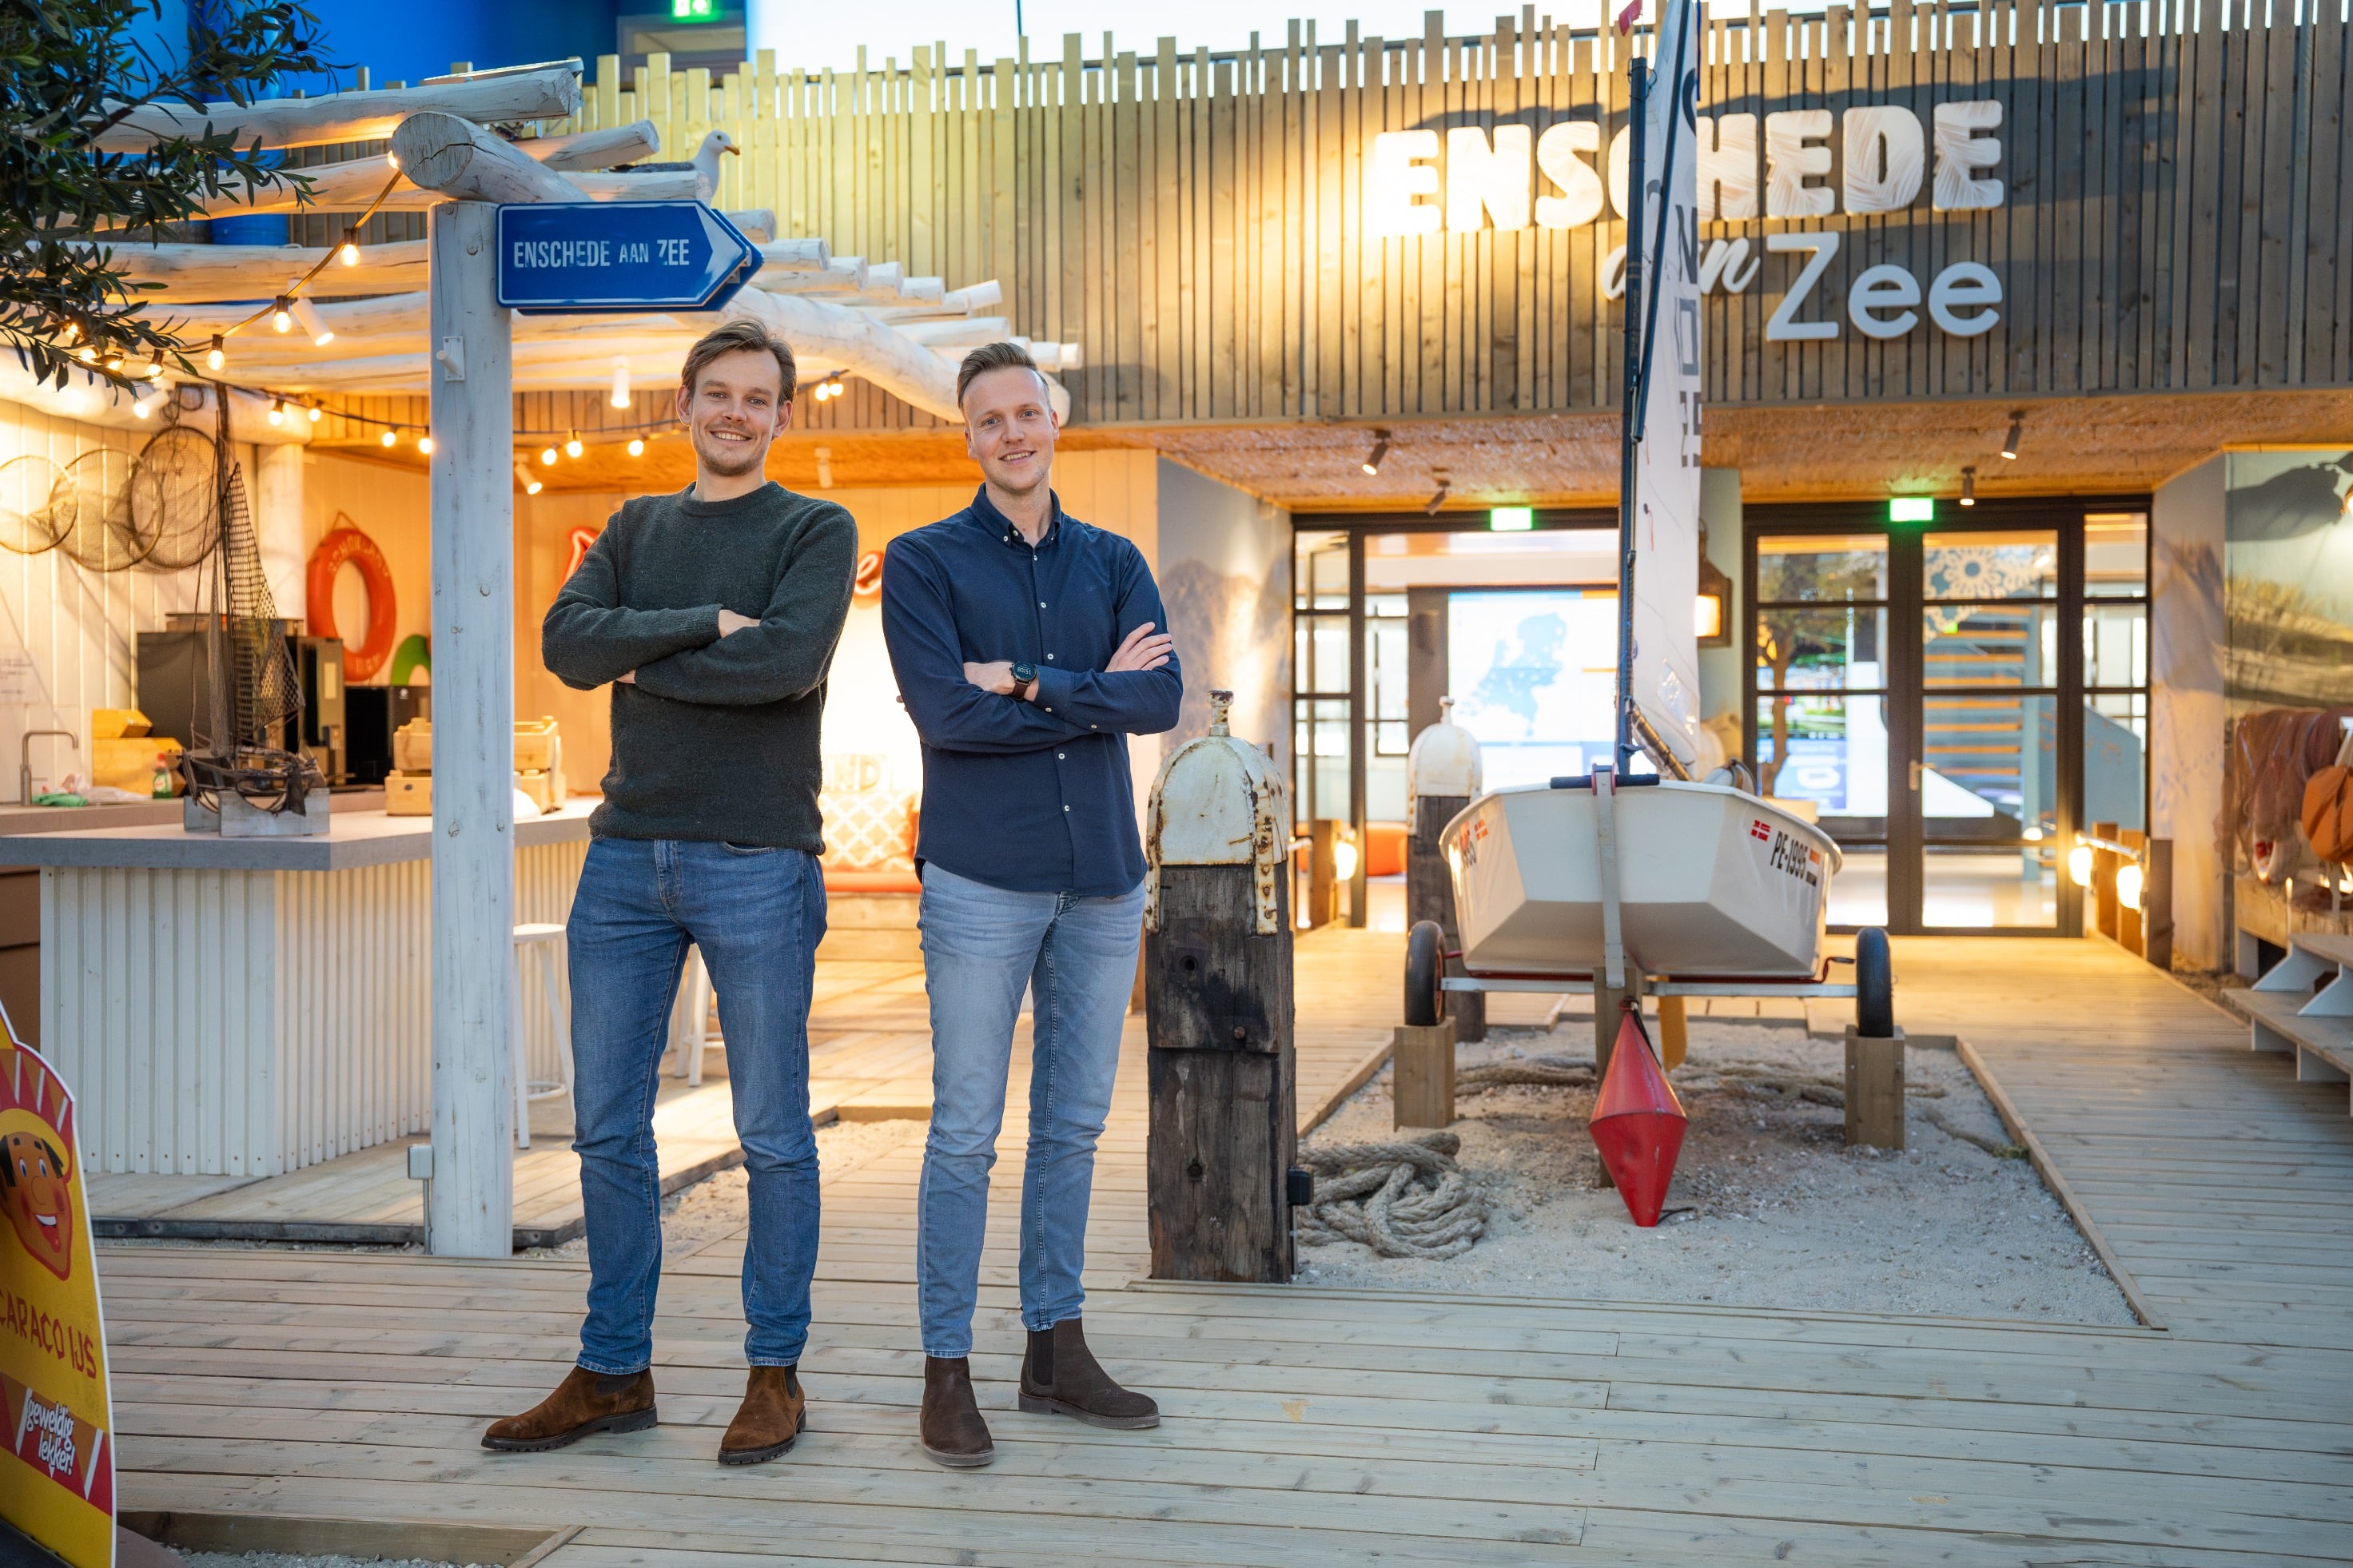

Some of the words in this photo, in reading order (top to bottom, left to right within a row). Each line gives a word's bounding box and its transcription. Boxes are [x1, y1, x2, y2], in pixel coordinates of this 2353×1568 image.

[1373, 100, 2004, 237] ENSHEDE
[513, 241, 611, 268] ENSCHEDE
[619, 243, 649, 263] AAN
[656, 239, 690, 265] ZEE
[1601, 237, 1761, 300] an
[1766, 231, 2004, 340] Zee
[68, 1325, 97, 1379] IJS
[26, 1398, 74, 1448] geweldig
[38, 1431, 76, 1476] lekker!
